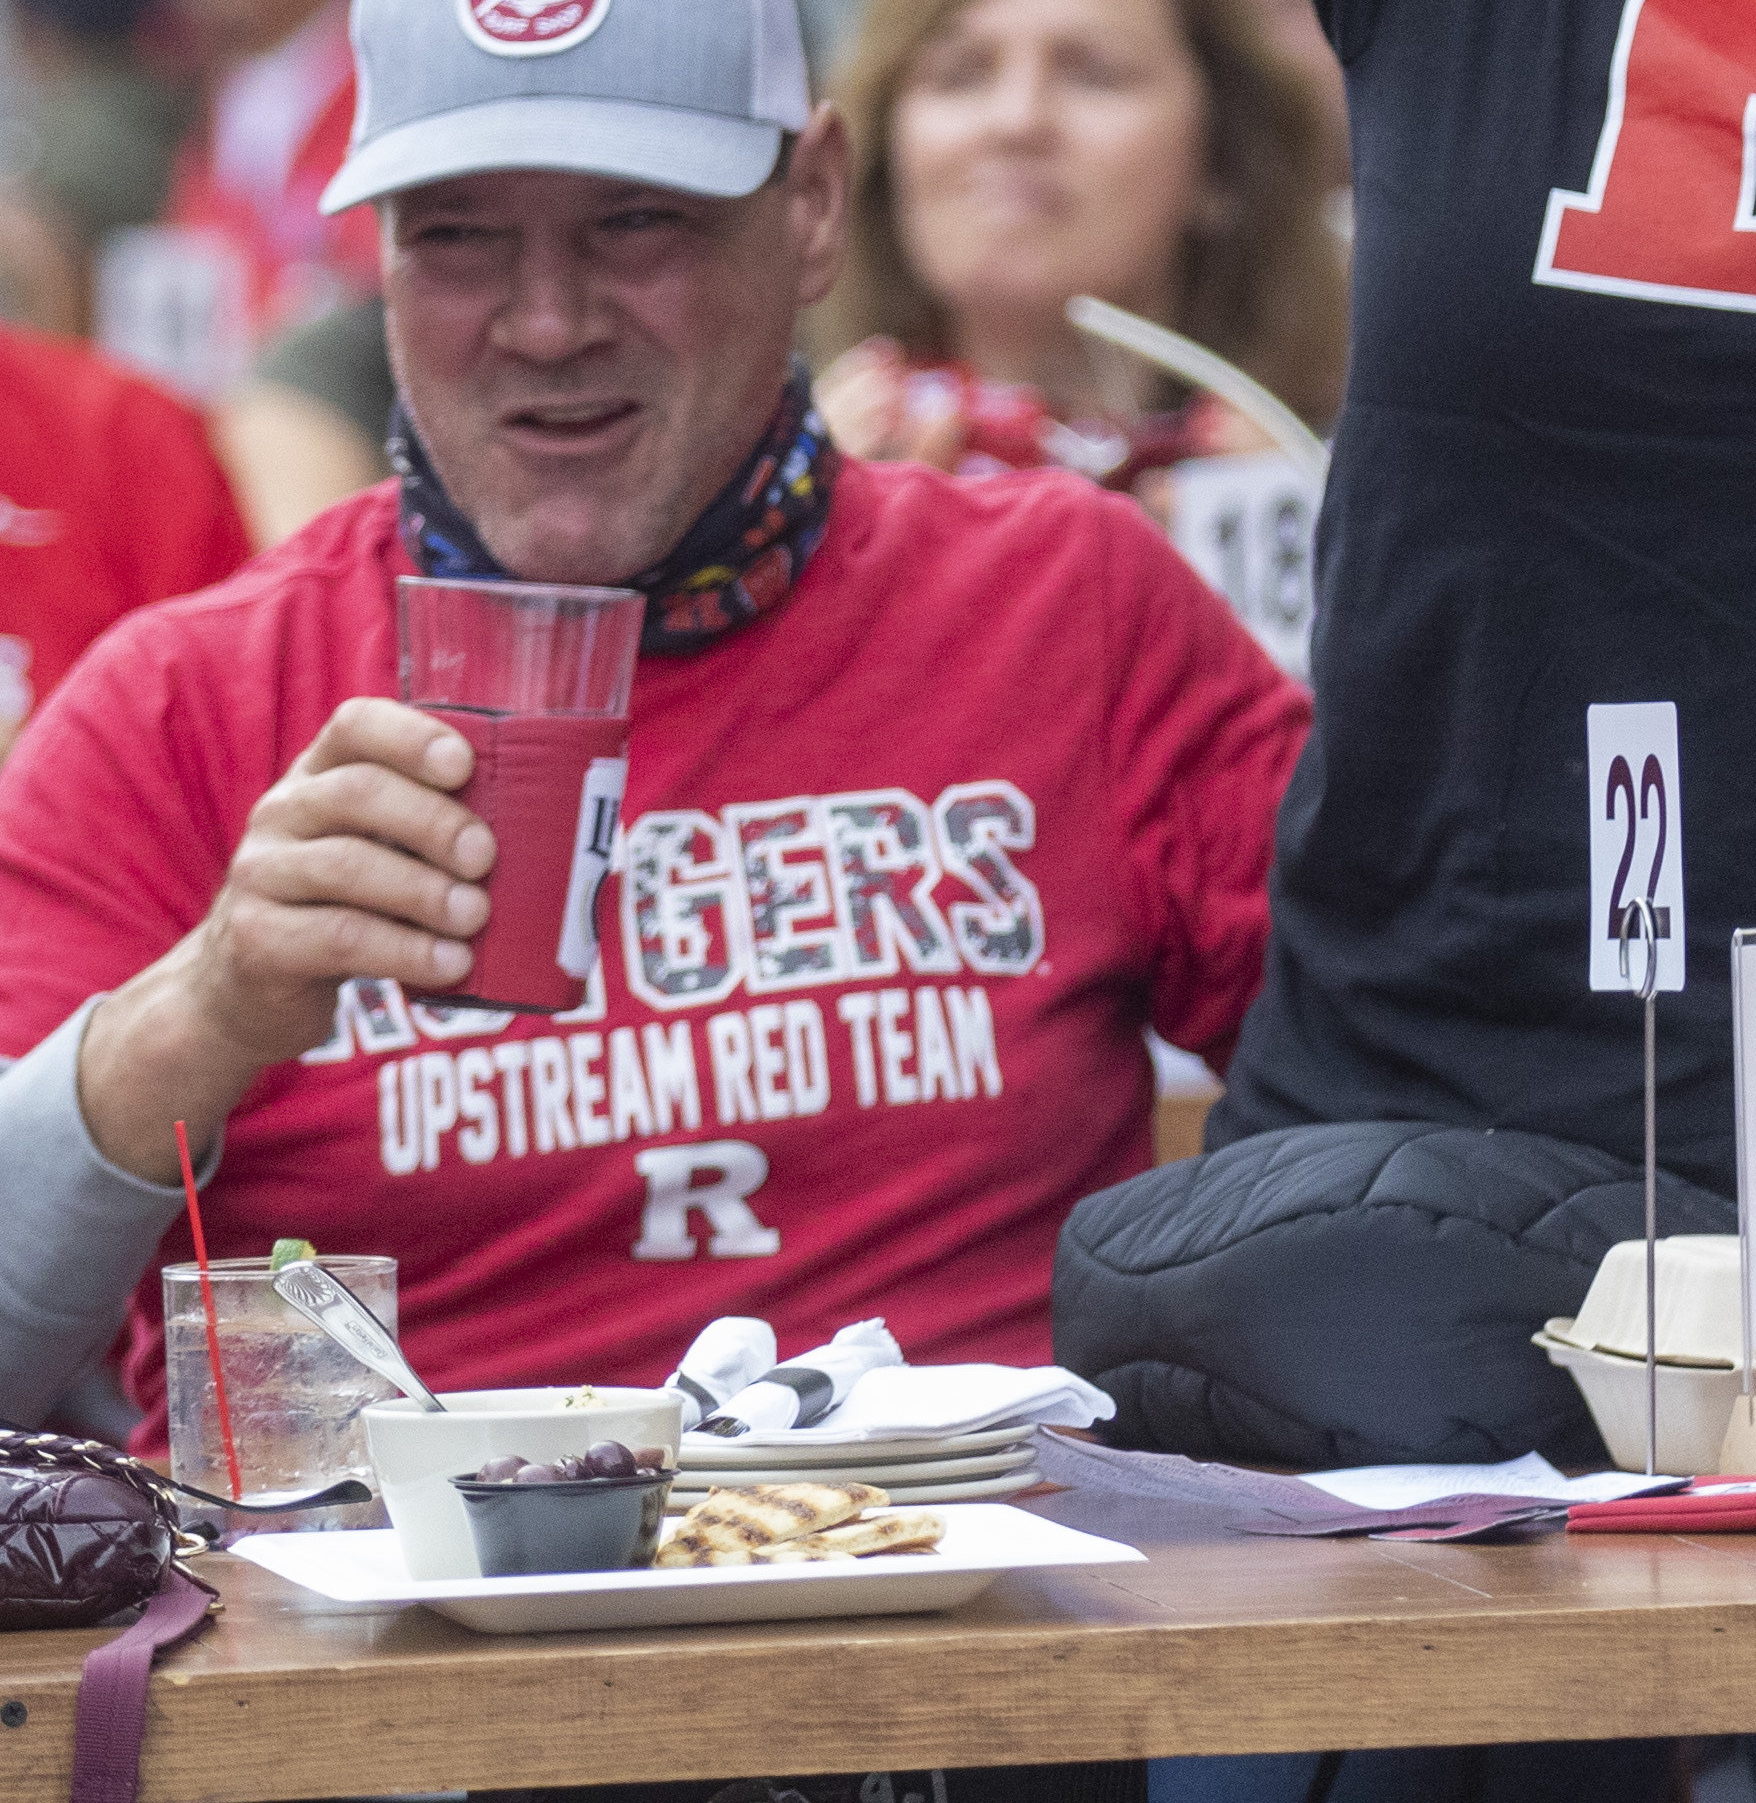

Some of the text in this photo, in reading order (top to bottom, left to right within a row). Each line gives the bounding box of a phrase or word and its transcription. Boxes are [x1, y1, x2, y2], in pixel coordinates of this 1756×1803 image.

[302, 779, 1047, 1063] GERS
[1606, 753, 1668, 940] 22
[377, 986, 1003, 1177] UPSTREAM RED TEAM
[632, 1140, 780, 1260] R
